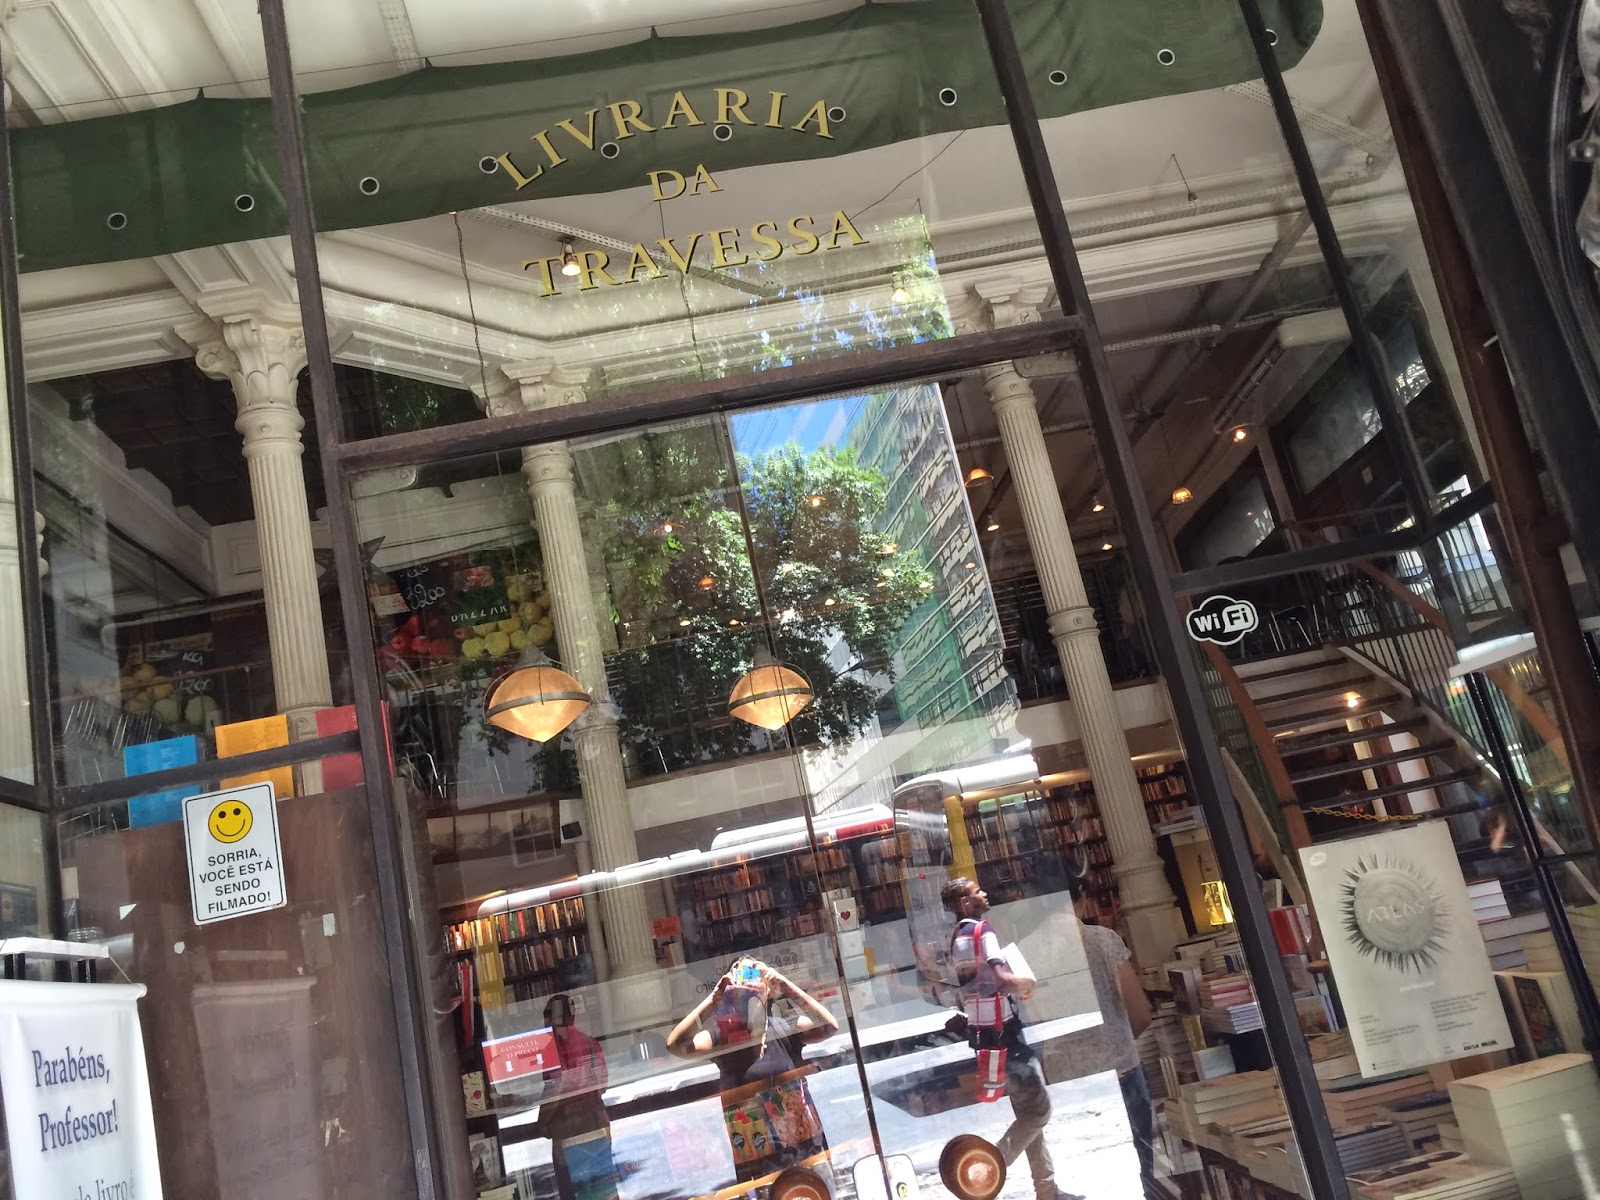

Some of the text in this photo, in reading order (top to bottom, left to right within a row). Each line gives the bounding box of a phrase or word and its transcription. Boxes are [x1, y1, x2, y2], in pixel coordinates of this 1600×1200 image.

[496, 88, 834, 191] LIVRARIA
[646, 163, 723, 202] DA
[522, 210, 870, 298] TRAVESSA
[199, 857, 273, 884] VOCÊ ESTÁ
[207, 848, 262, 867] SORRIA,
[208, 891, 271, 914] FILMADO!
[215, 877, 261, 896] SENDO
[31, 1046, 110, 1088] Parabéns,
[38, 1098, 119, 1152] Professor!
